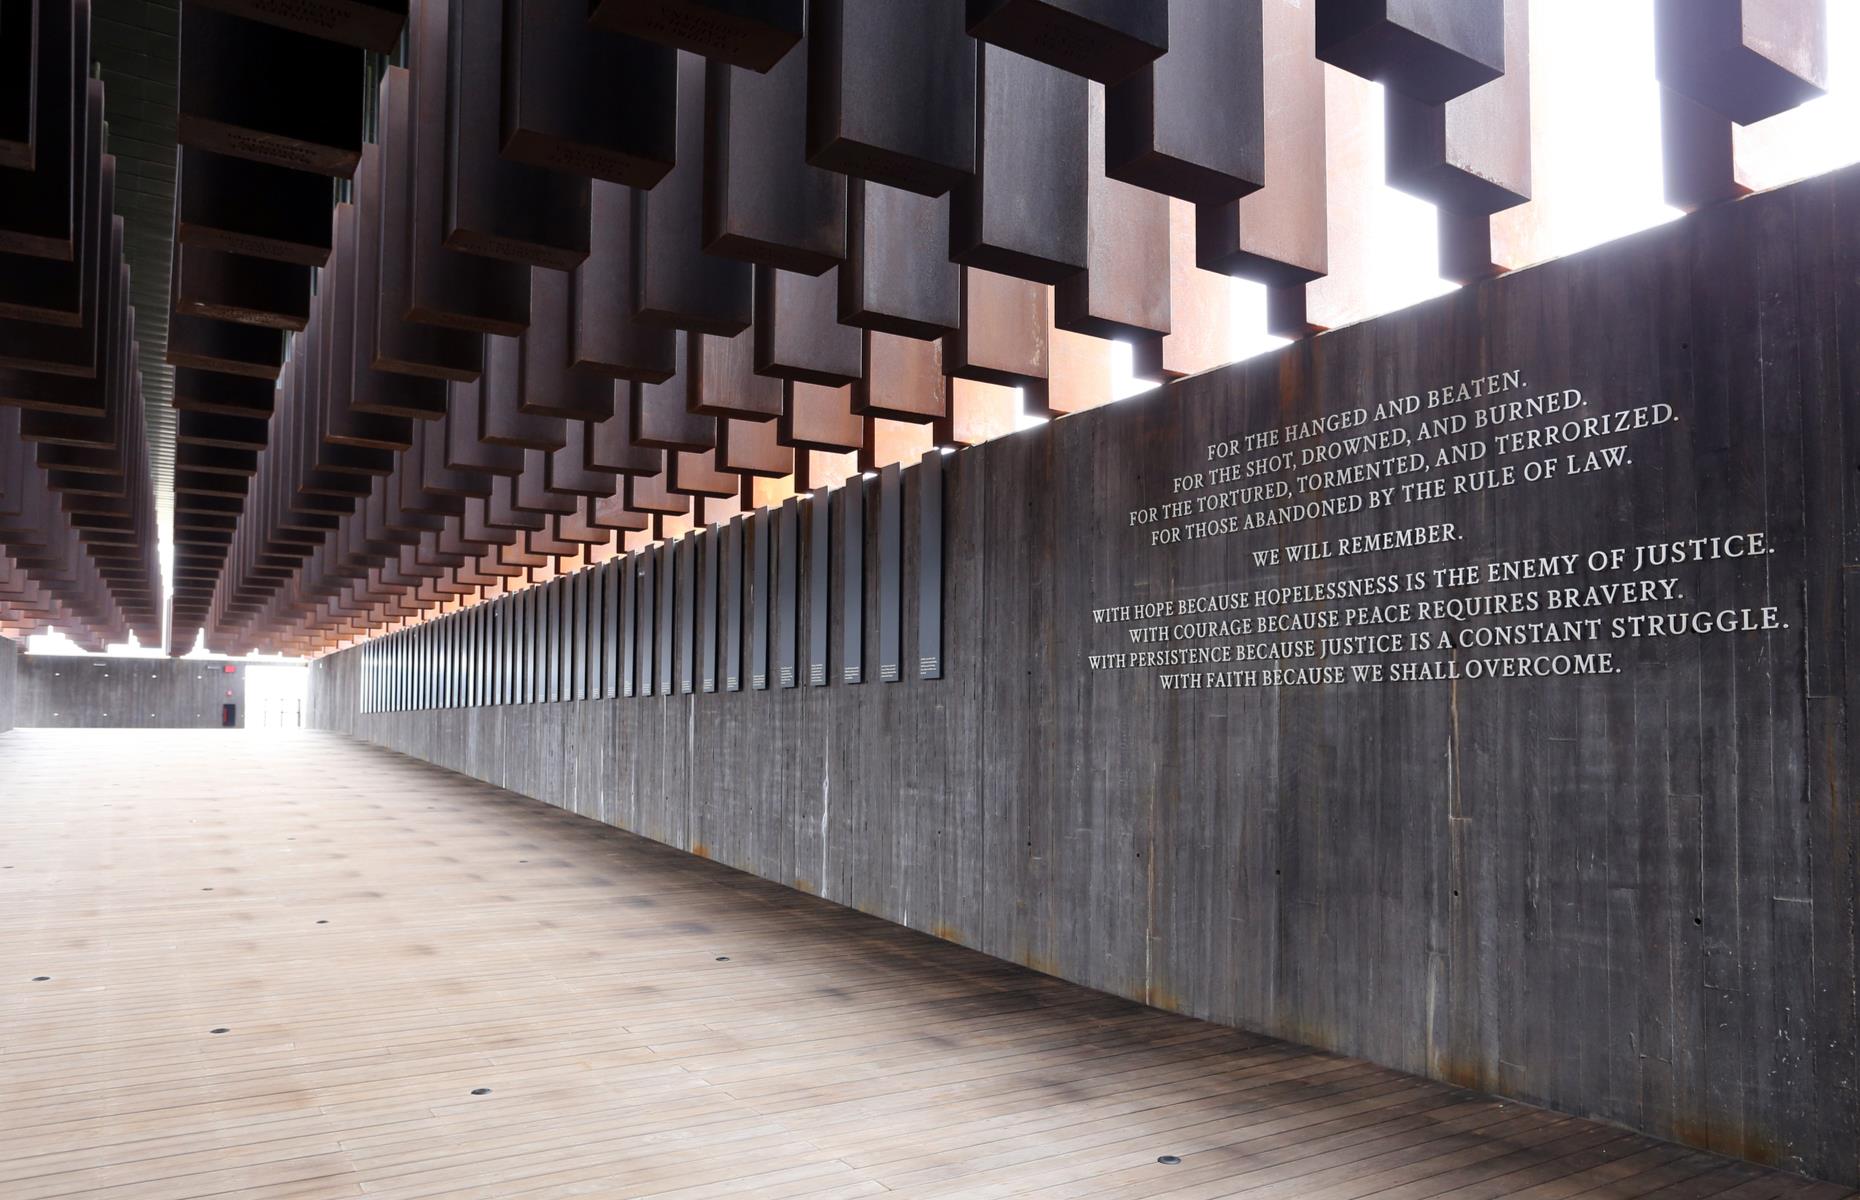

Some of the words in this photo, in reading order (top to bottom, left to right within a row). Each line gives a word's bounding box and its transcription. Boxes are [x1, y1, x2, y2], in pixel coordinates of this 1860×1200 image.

[1174, 474, 1203, 493] FOR
[1209, 464, 1240, 485] THE
[1247, 451, 1296, 477] SHOT,
[1302, 428, 1411, 465] DROWNED,
[1417, 415, 1466, 440] AND
[1475, 389, 1587, 429] BURNED.
[1208, 440, 1239, 460] FOR
[1245, 430, 1279, 451] THE
[1285, 409, 1367, 442] HANGED
[1374, 396, 1420, 421] AND
[1428, 370, 1526, 408] BEATEN.
[1130, 508, 1158, 526] FOR
[1162, 500, 1192, 519] THE
[1197, 482, 1292, 512] TORTURED,
[1297, 454, 1429, 493] TORMENTED,
[1435, 441, 1486, 467] AND
[1495, 404, 1678, 454] TERRORIZED.
[1152, 528, 1180, 545] FOR
[1185, 517, 1238, 539] THOSE
[1243, 495, 1362, 529] ABANDONED
[1369, 488, 1395, 508] BY
[1402, 479, 1446, 502] THE
[1454, 466, 1515, 494] RULE
[1524, 458, 1557, 481] OF
[1567, 445, 1632, 474] LAW.
[1093, 606, 1129, 623] WITH
[1134, 601, 1173, 619] HOPE
[1178, 593, 1248, 614] BECAUSE
[1255, 575, 1398, 606] HOPELESSNESS
[1406, 572, 1425, 591] IS
[1433, 566, 1479, 588] THE
[1488, 554, 1579, 582] ENEMY
[1588, 549, 1625, 571] OF
[1633, 533, 1774, 572] JUSTICE.
[1252, 549, 1279, 566] WE
[1285, 541, 1332, 562] WILL
[1338, 523, 1462, 555] REMEMBER.
[1088, 654, 1125, 669] WITH
[1130, 646, 1231, 666] PERSISTENCE
[1236, 640, 1314, 662] BECAUSE
[1320, 634, 1402, 659] JUSTICE
[1410, 632, 1430, 650] IS
[1437, 631, 1453, 649] A
[1459, 618, 1601, 647] CONSTANT
[1612, 606, 1789, 640] STRUGGLE.
[1129, 626, 1169, 643] WITH
[1174, 619, 1252, 639] COURAGE
[1257, 610, 1339, 632] BECAUSE
[1345, 604, 1411, 625] PEACE
[1418, 592, 1538, 621] REQUIRES
[1547, 578, 1683, 609] BRAVERY.
[1160, 673, 1201, 689] WITH
[1207, 671, 1256, 687] FAITH
[1262, 666, 1344, 686] BECAUSE
[1351, 665, 1383, 682] WE
[1390, 660, 1460, 681] SHALL
[1466, 653, 1621, 678] OVERCOME.
